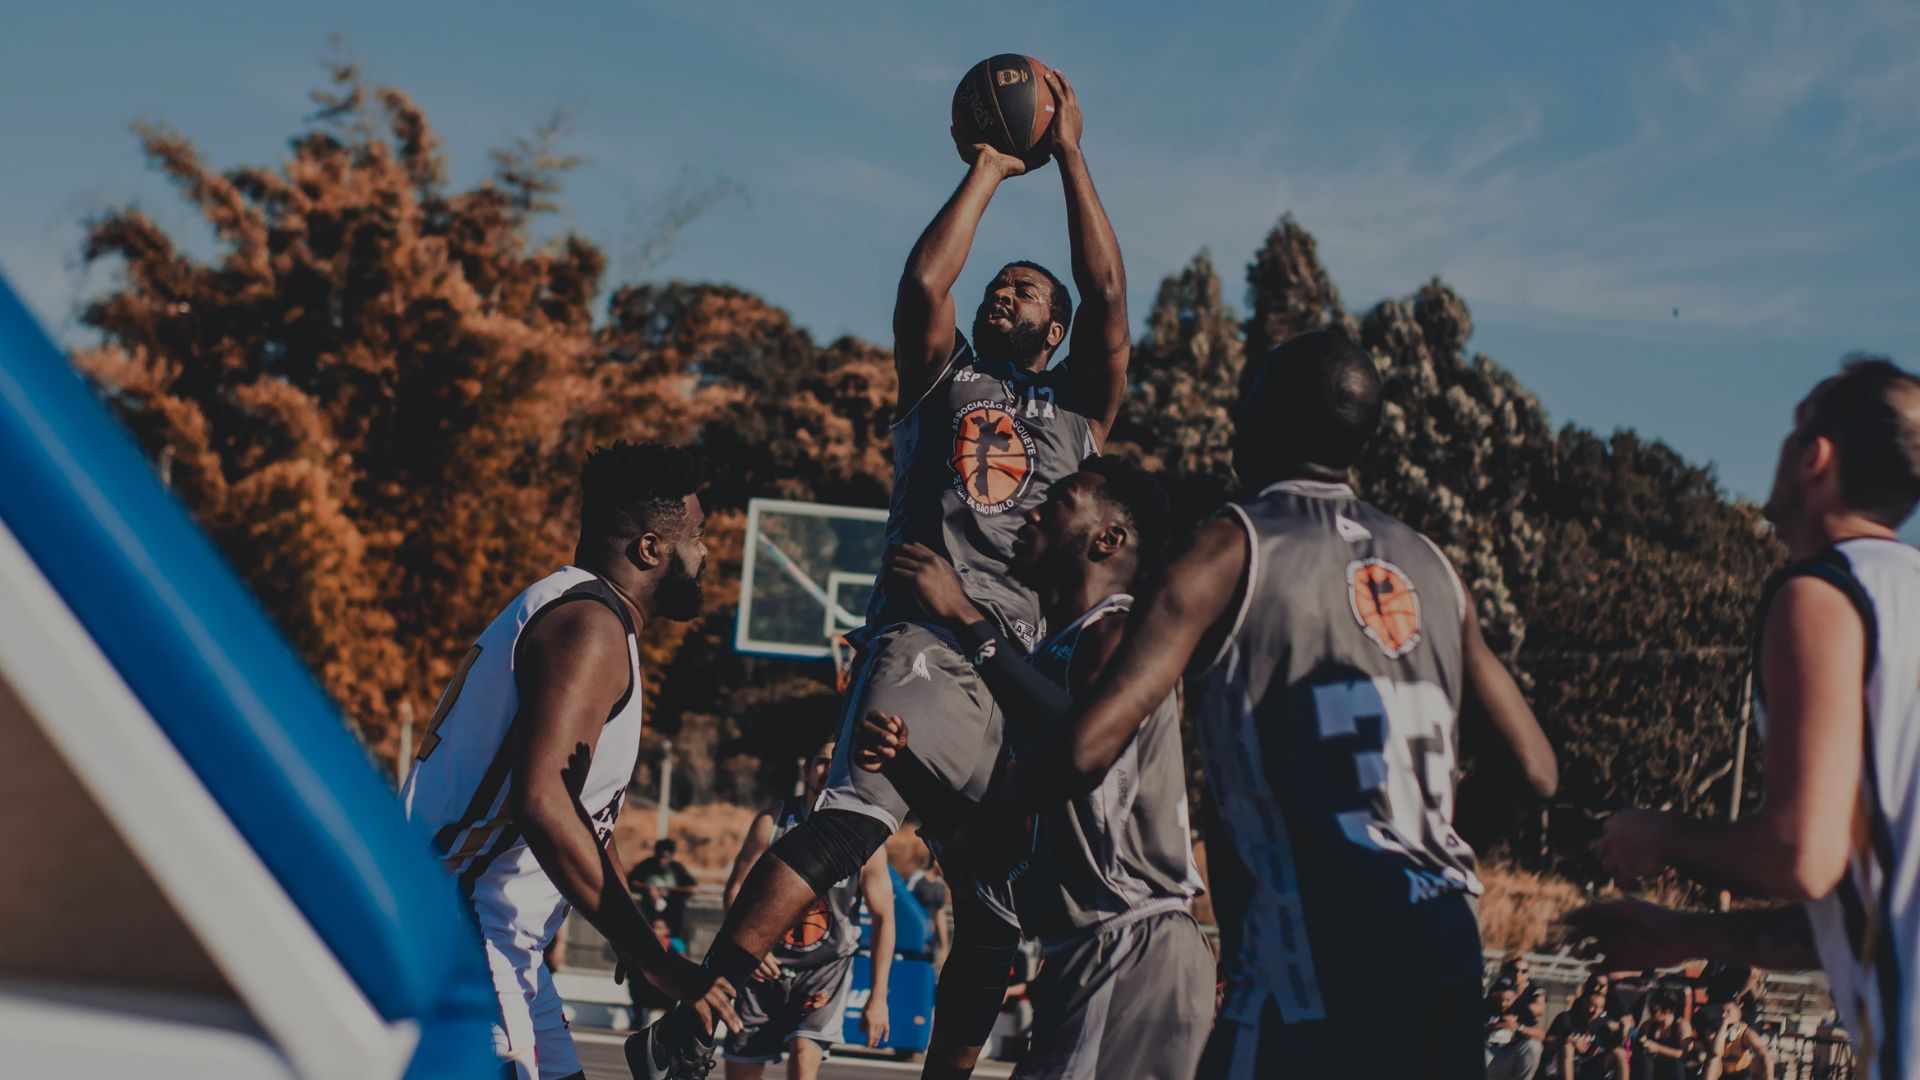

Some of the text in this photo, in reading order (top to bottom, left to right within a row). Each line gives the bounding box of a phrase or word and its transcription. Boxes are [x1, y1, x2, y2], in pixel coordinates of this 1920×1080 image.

[953, 400, 1003, 430] ASSOCIAÇÃO
[1012, 418, 1036, 456] SQUETE
[966, 496, 976, 508] DE
[975, 502, 989, 514] SÃO
[989, 498, 1014, 515] PAULO
[1313, 675, 1475, 866] 33
